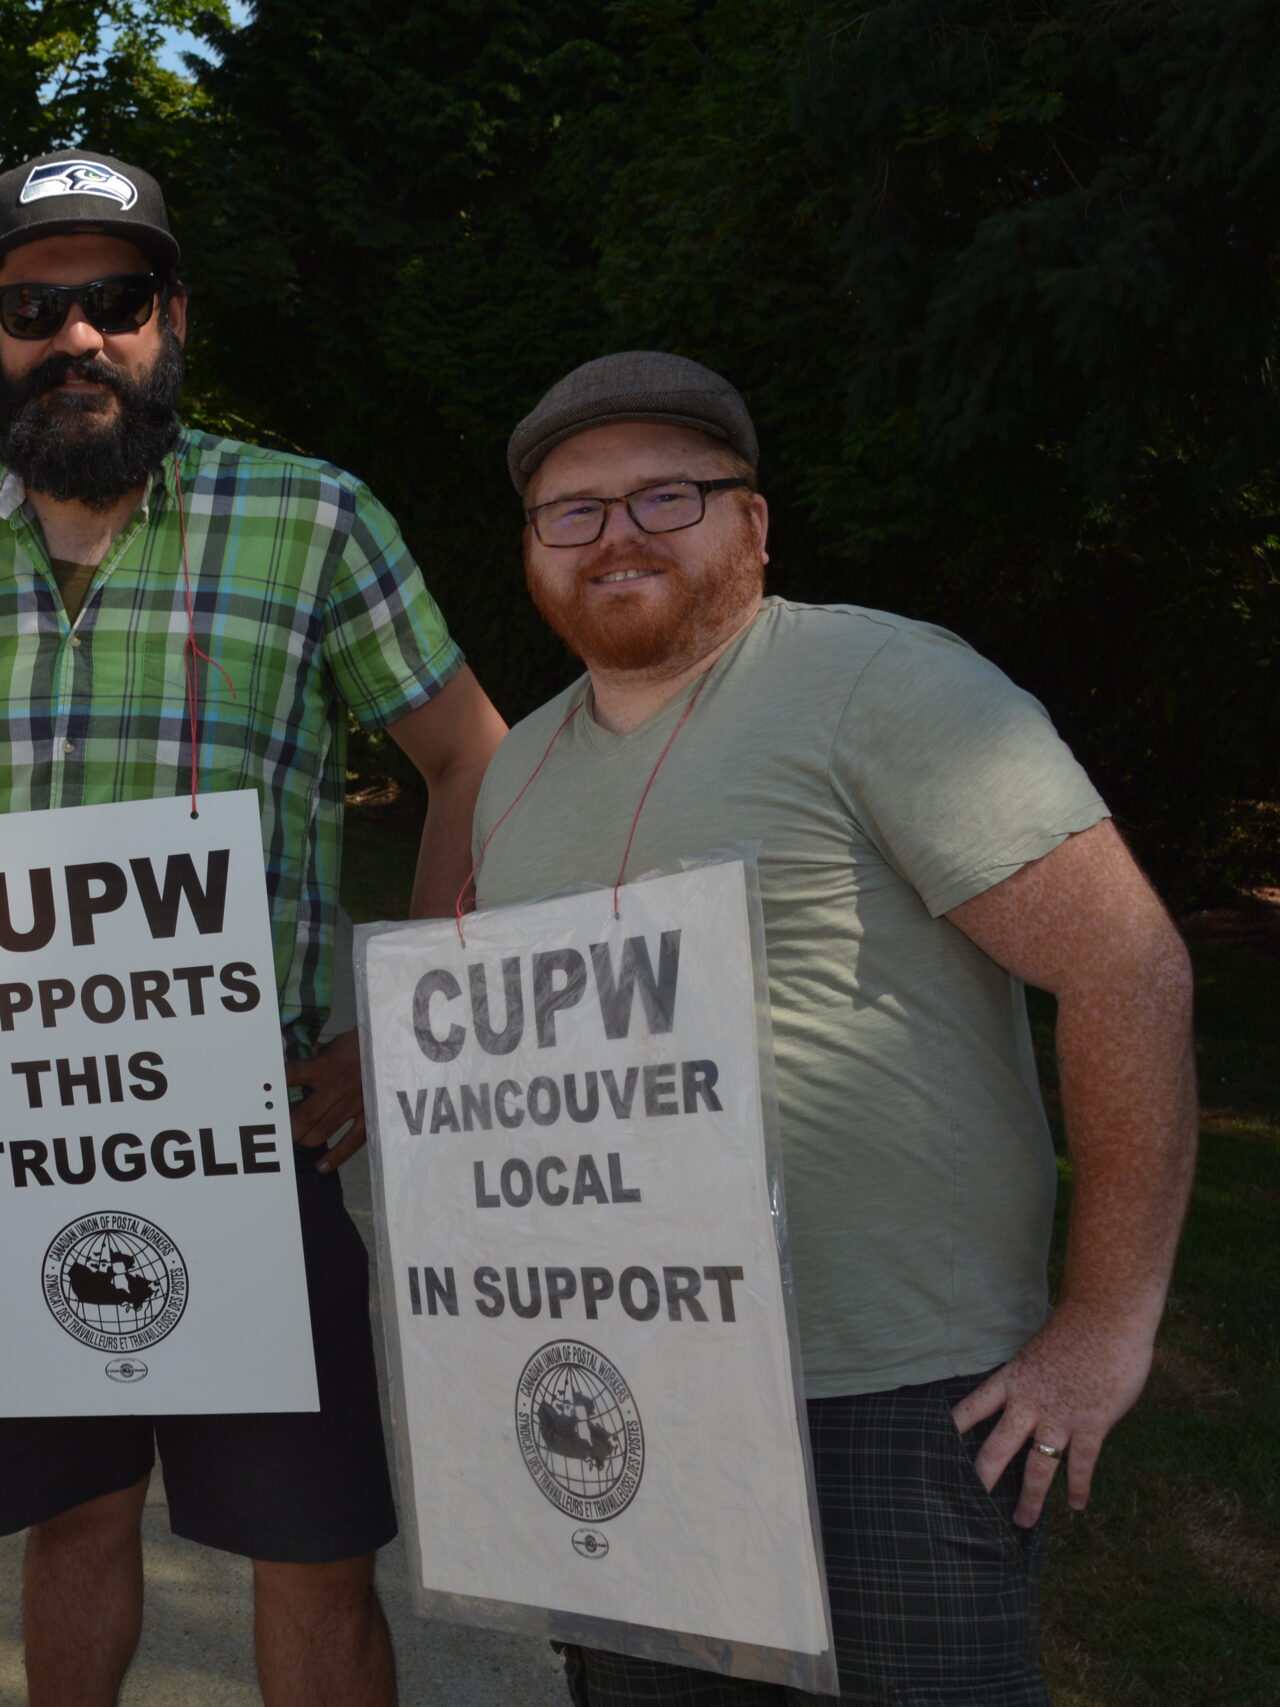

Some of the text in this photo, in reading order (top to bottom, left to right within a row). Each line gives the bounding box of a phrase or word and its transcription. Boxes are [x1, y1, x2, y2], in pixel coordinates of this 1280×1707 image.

[411, 929, 682, 1063] CUPW
[11, 1051, 168, 1109] THIS
[396, 1059, 723, 1136] VANCOUVER
[474, 1152, 641, 1209] LOCAL
[49, 1215, 174, 1262] CANADIAN UNION OF POSTAL WORKERS
[46, 1267, 185, 1350] SYNDICAT DES TRAVAILLEURS ET TRAVAILLEUSES DES POSTES
[408, 1264, 744, 1323] IN SUPPORT
[520, 1345, 630, 1404] CANADIAN UNION OF POSTAL WORKERS
[518, 1412, 641, 1518] SYNDICAT DES TRAVAILLEURS ET TRAVAILLEUSES DES POSTES
